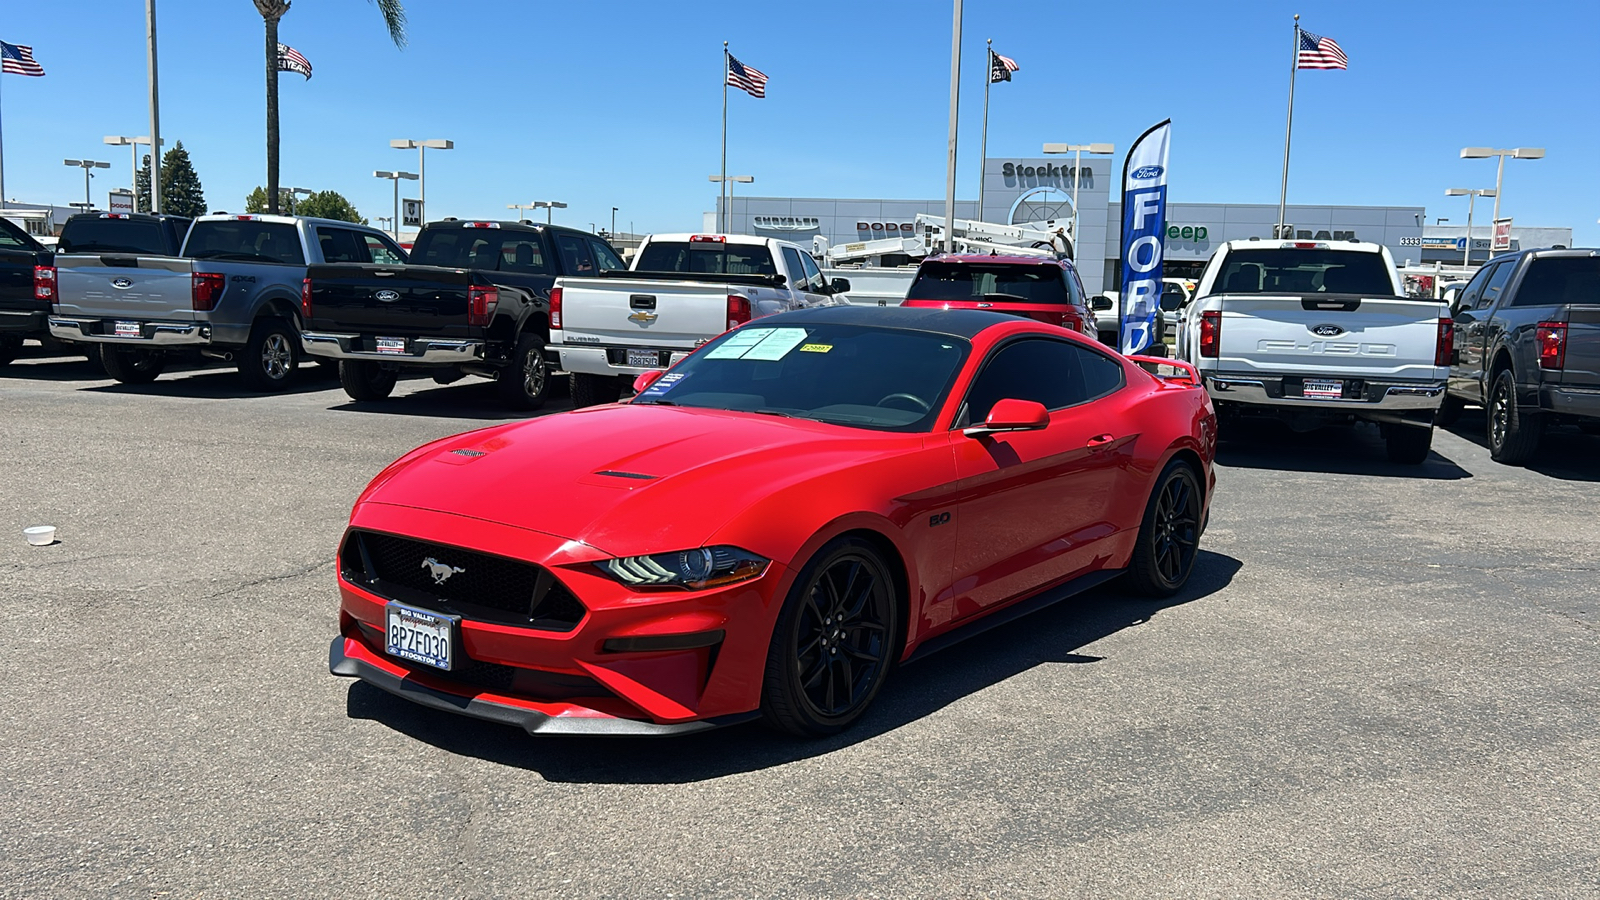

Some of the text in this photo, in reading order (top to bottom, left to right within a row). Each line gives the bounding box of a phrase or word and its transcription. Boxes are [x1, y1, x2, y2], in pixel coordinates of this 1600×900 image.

[1002, 162, 1093, 178] Stockton
[1136, 168, 1160, 179] Ford
[856, 222, 914, 231] DODG
[1296, 230, 1355, 241] RAM
[1400, 237, 1421, 246] 3333
[1122, 191, 1162, 355] FORD
[1314, 325, 1342, 336] Ford
[1257, 339, 1397, 357] F-150
[400, 608, 435, 623] BIG VALLEY
[391, 624, 448, 661] 8PZF030
[400, 650, 436, 665] STOCKTON
